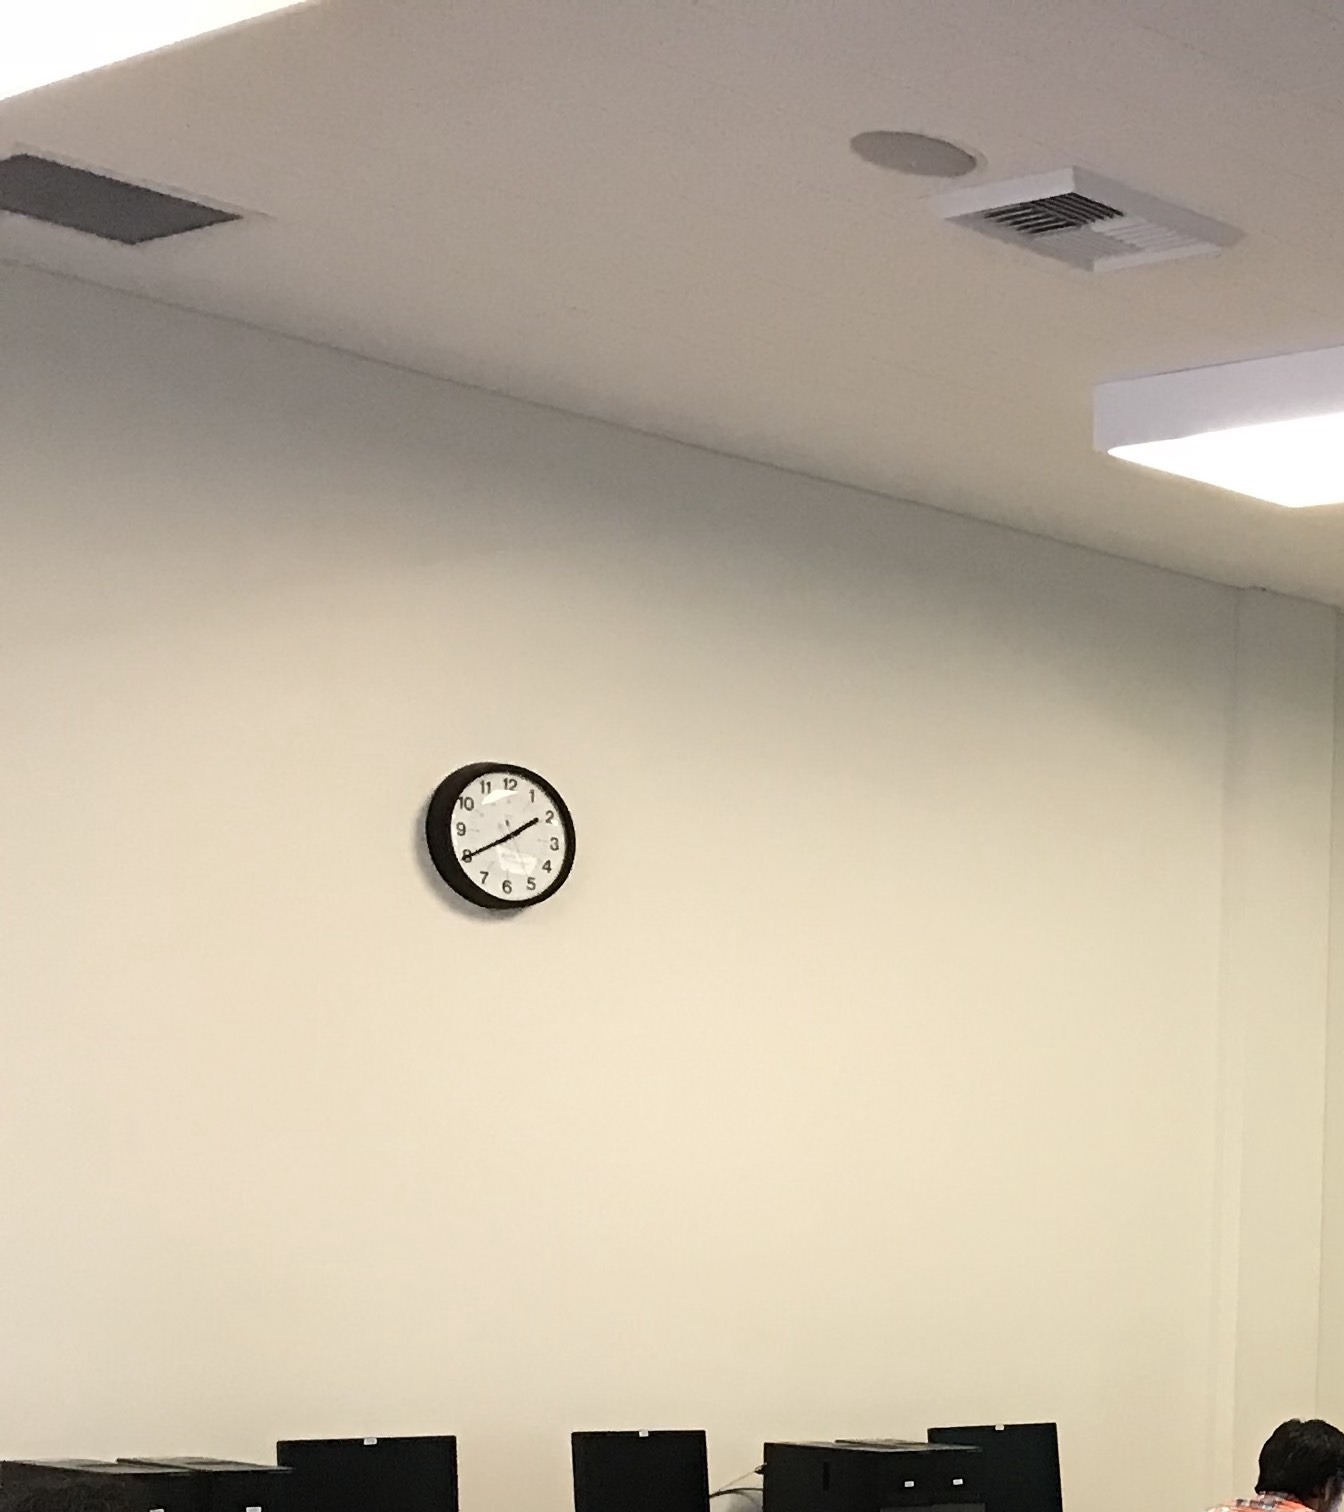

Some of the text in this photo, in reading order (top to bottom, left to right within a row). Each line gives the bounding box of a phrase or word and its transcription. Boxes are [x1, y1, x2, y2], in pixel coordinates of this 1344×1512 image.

[480, 781, 492, 794] 11
[503, 778, 518, 791] 12
[529, 789, 535, 803] 1
[458, 797, 475, 811] 10
[545, 810, 555, 824] 2
[456, 822, 466, 836] 9
[549, 837, 560, 851] 3
[542, 860, 552, 873] 4
[480, 871, 489, 884] 7
[526, 877, 536, 890] 5
[502, 880, 513, 894] 6
